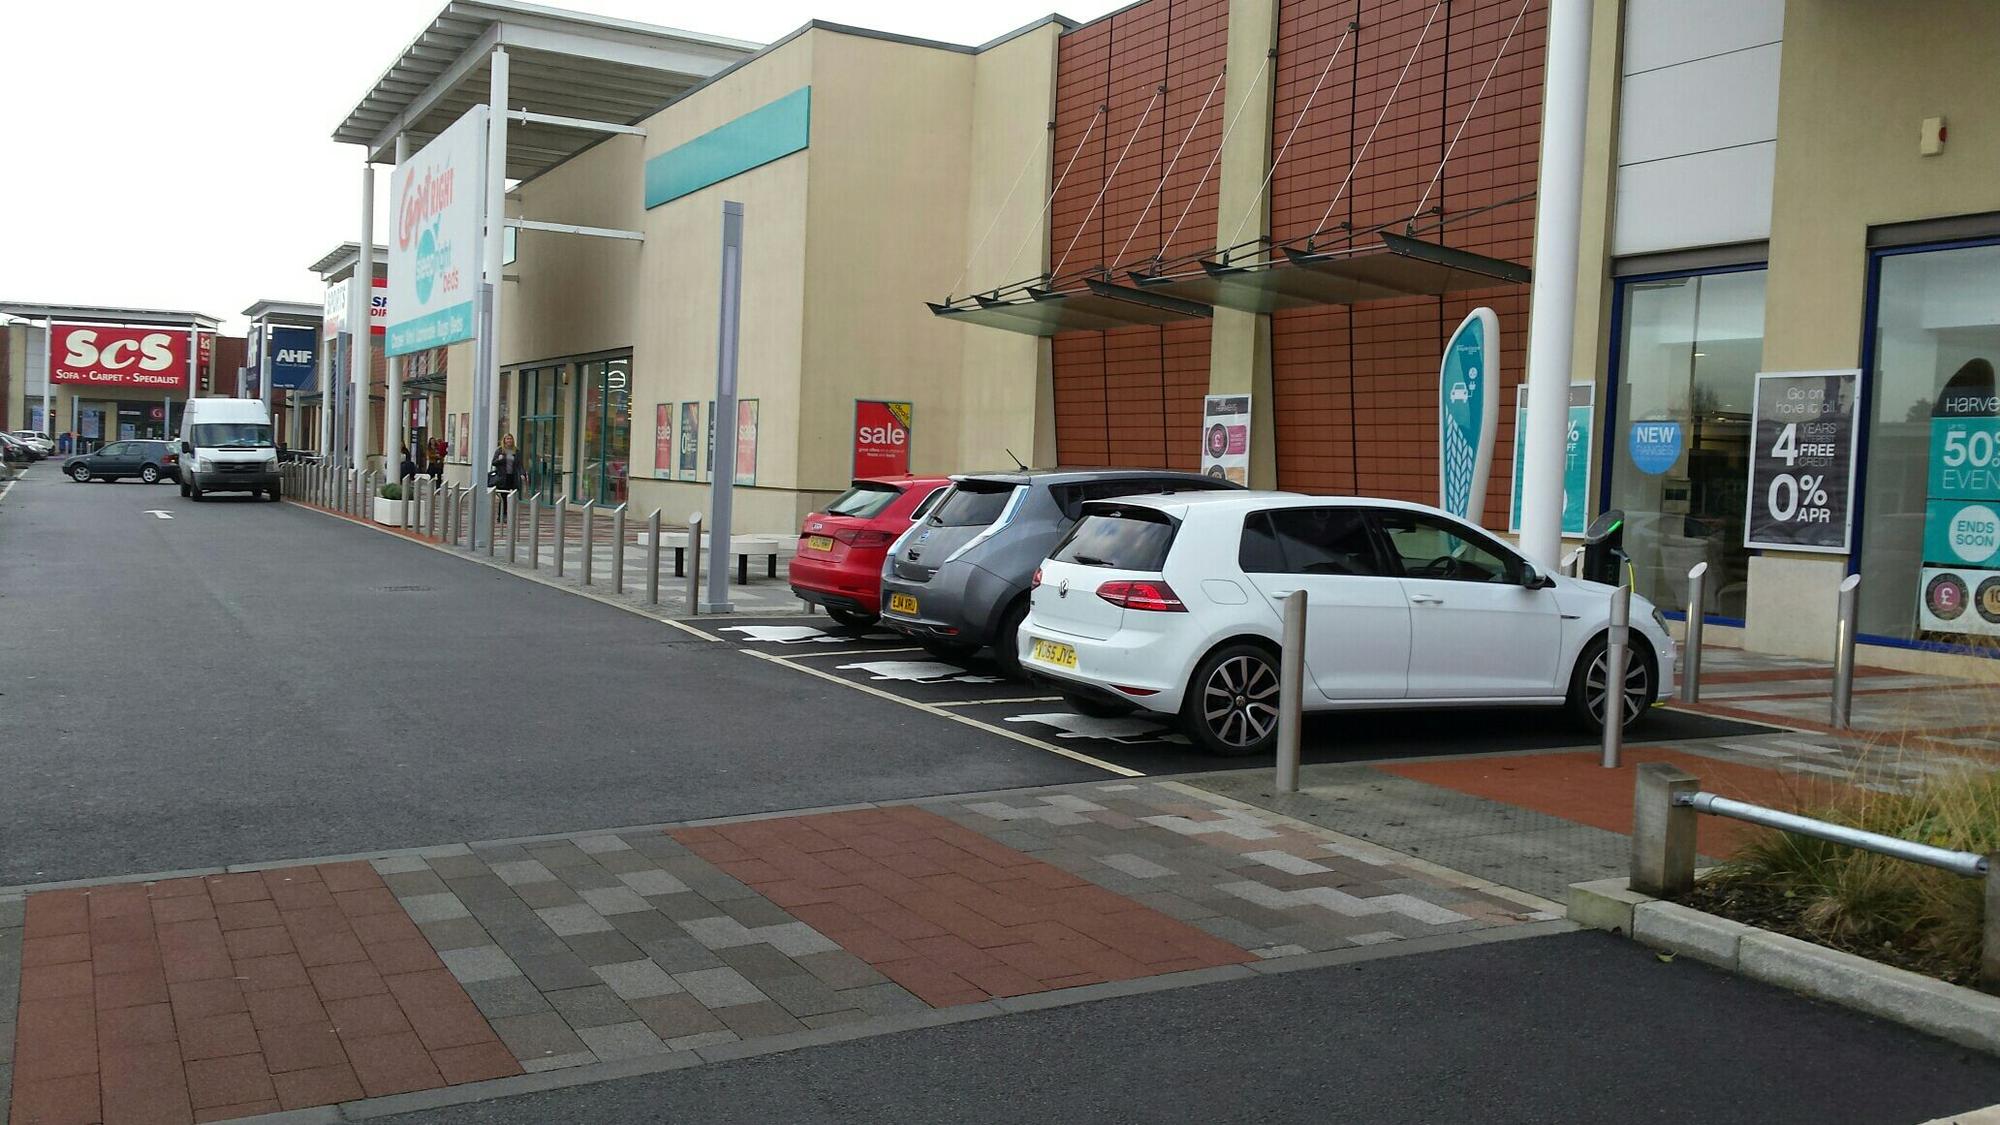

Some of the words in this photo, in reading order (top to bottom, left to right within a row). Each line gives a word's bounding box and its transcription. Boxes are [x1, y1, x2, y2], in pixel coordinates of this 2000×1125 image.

[63, 329, 173, 371] ScS
[276, 349, 312, 363] AHF
[89, 370, 123, 382] CARPET
[132, 372, 179, 385] SPECIALIST
[1787, 387, 1806, 400] Go
[859, 422, 905, 445] sale
[1636, 426, 1675, 443] NEW
[1771, 423, 1799, 466] 4
[1801, 422, 1837, 434] YEARS
[1799, 443, 1835, 456] FREE
[1798, 456, 1833, 467] CREDIT
[1768, 473, 1828, 521] 0%
[1796, 507, 1831, 523] APR
[1957, 520, 1994, 533] ENDS
[1956, 534, 1994, 546] SOON
